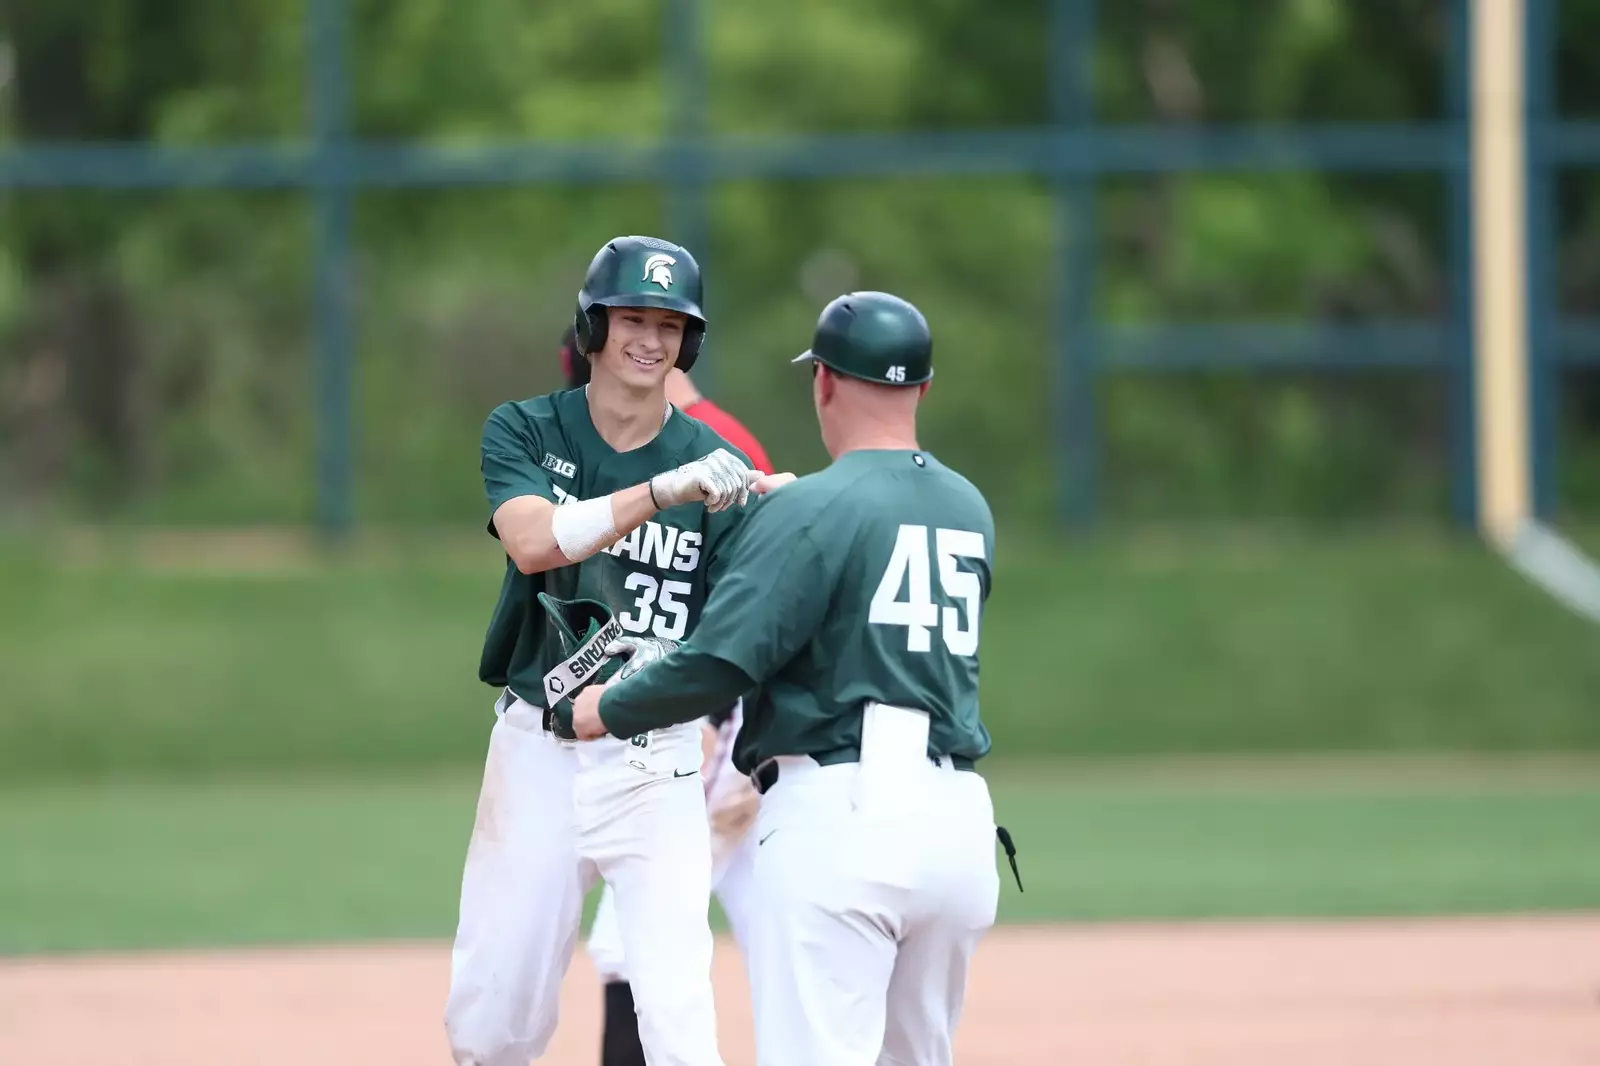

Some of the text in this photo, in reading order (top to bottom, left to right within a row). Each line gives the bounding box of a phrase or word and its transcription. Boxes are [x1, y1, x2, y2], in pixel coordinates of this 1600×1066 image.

[885, 365, 906, 382] 45
[619, 572, 692, 641] 35
[868, 524, 985, 656] 45
